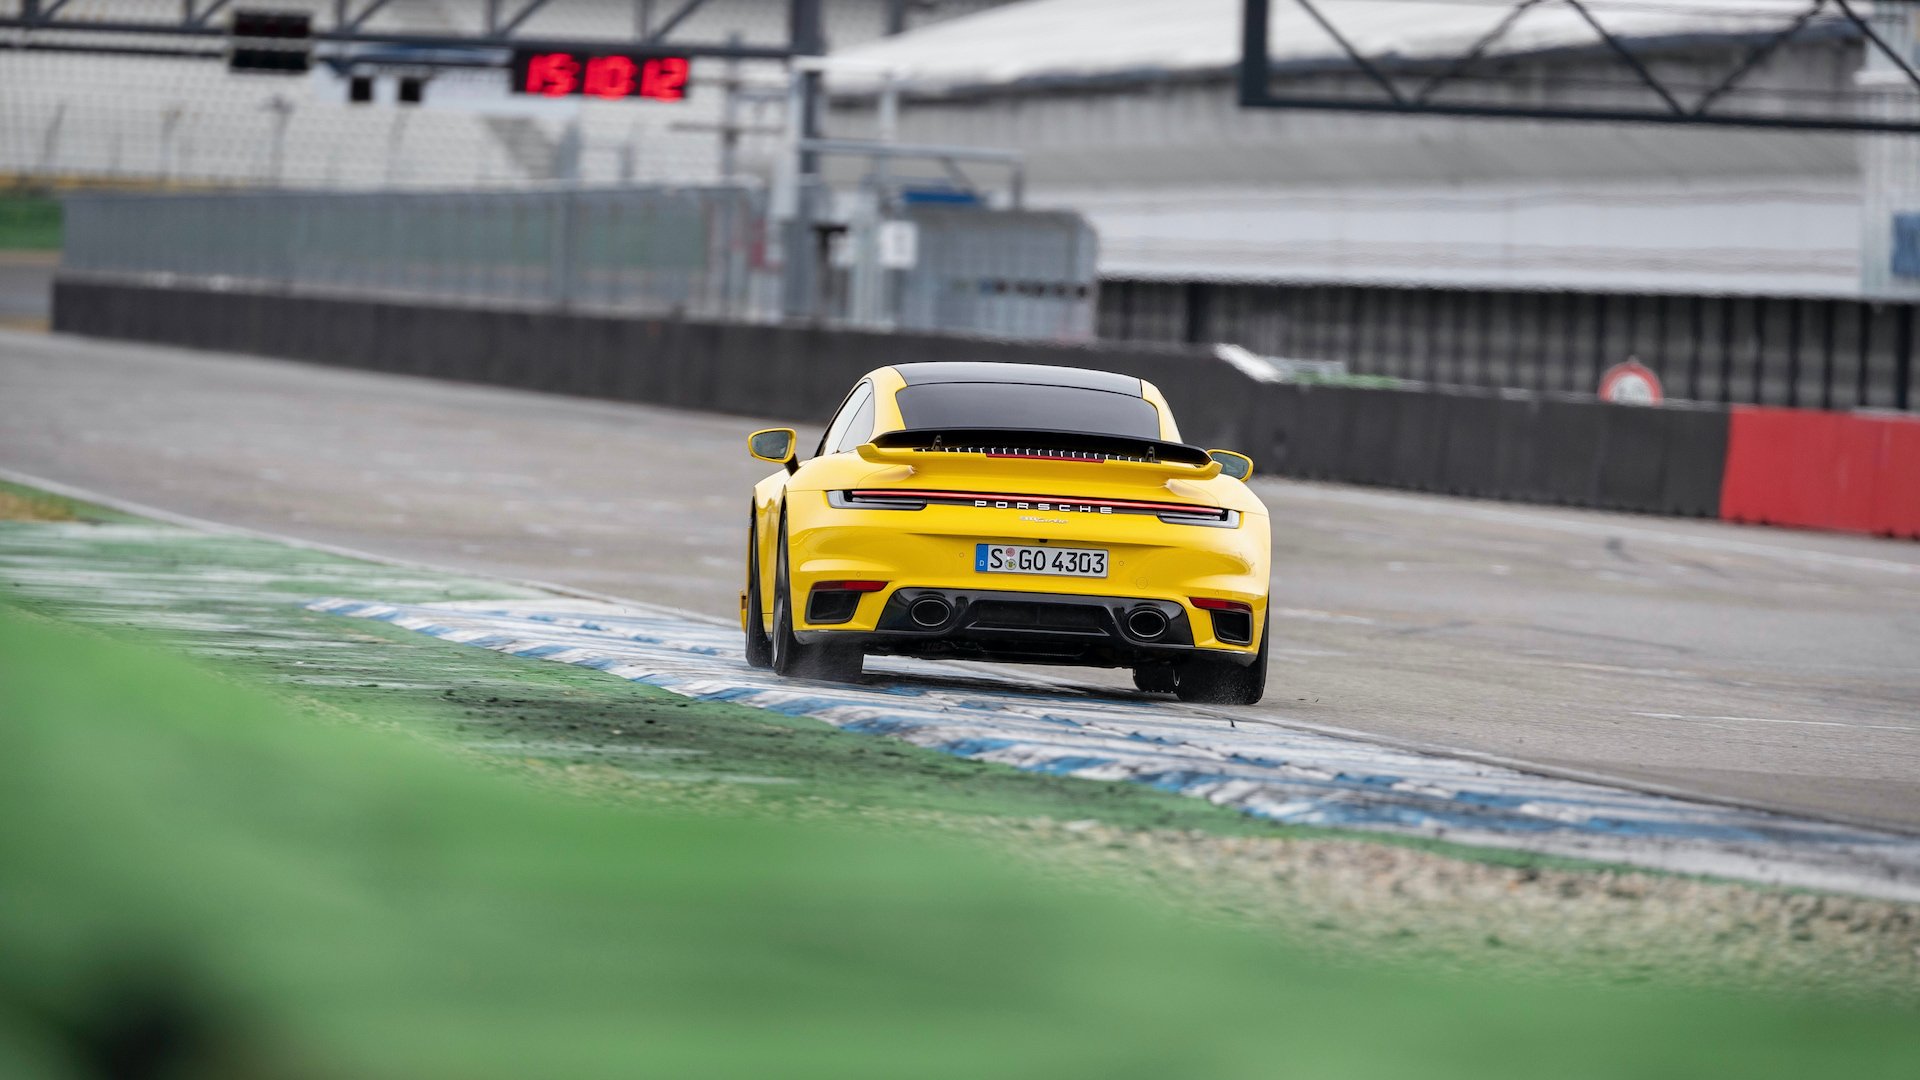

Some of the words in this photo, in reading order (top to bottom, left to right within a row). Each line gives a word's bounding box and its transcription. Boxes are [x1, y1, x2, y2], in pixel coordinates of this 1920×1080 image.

[974, 500, 1113, 514] PORSCHE
[990, 548, 1003, 569] S
[1019, 549, 1046, 571] GO
[1051, 551, 1105, 574] 4303
